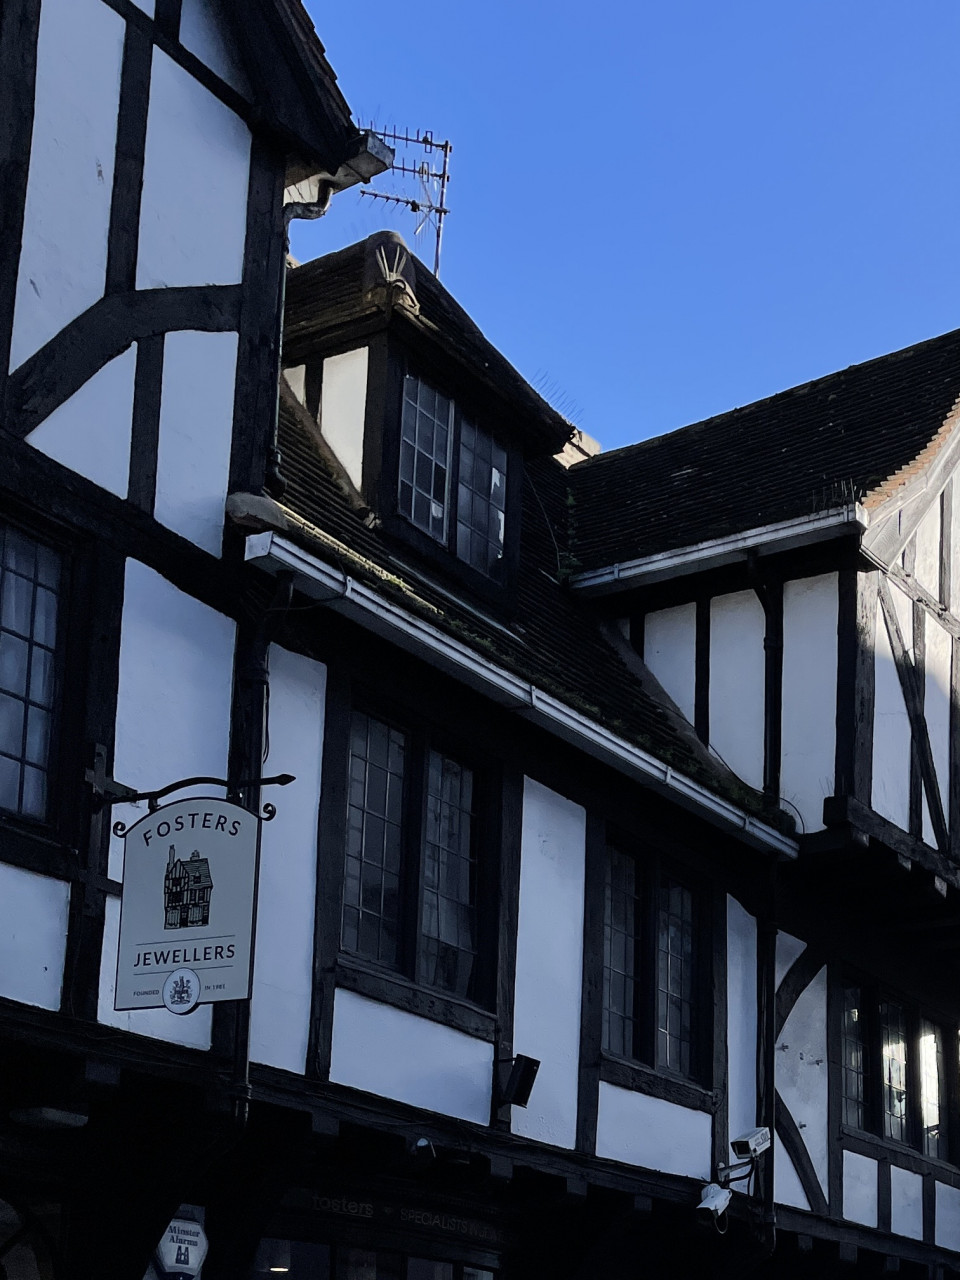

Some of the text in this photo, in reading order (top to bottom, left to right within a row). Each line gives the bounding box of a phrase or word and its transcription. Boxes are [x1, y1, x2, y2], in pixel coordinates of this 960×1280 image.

[143, 812, 242, 846] FOSTERS
[133, 944, 235, 967] JEWELLERS
[167, 1225, 200, 1237] Minster
[400, 1207, 468, 1233] SPECIALISTS
[169, 1235, 198, 1246] Alarms
